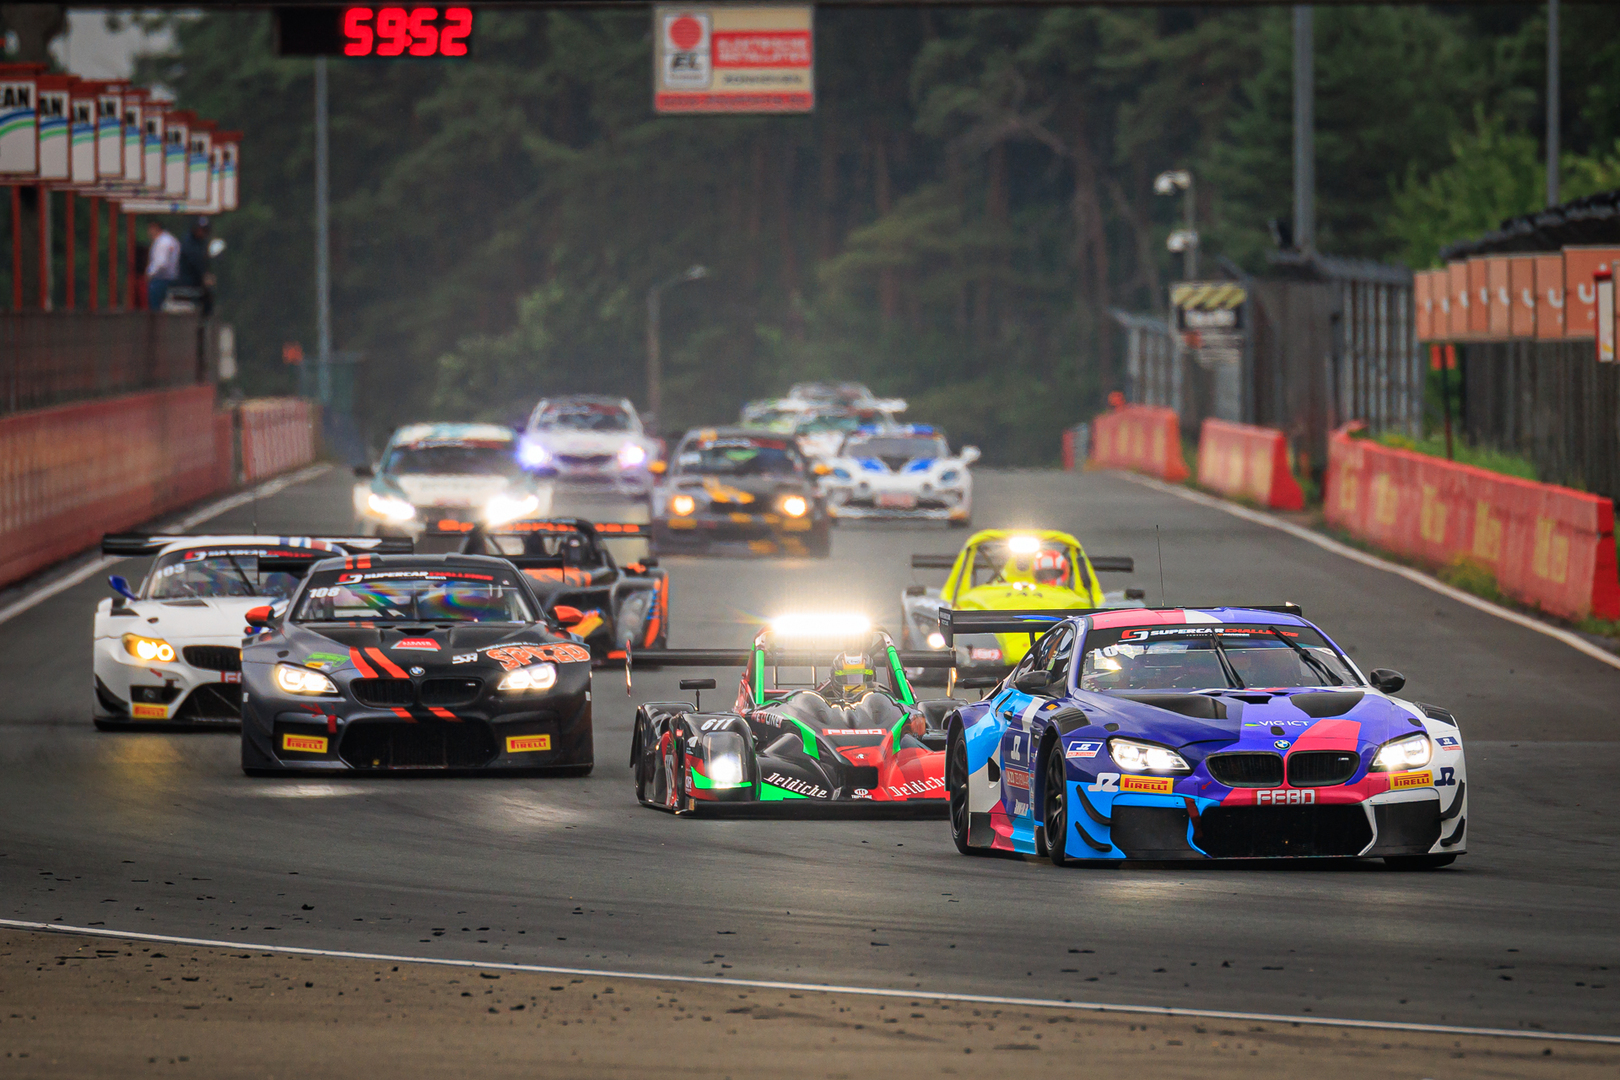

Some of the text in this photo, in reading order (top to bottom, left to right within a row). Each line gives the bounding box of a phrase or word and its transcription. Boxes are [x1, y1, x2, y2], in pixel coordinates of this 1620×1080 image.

[156, 563, 186, 579] 103
[364, 571, 429, 579] SUPERCAR
[310, 587, 340, 598] 108
[1151, 628, 1224, 636] SUPERCAR
[701, 719, 734, 730] 611
[287, 737, 324, 750] PIRELLI
[510, 738, 547, 749] PIRELLI
[764, 772, 828, 798] Deldiche
[1124, 777, 1168, 791] PIRELLI
[1394, 774, 1430, 787] PIRELLI
[1257, 789, 1315, 805] FEBO
